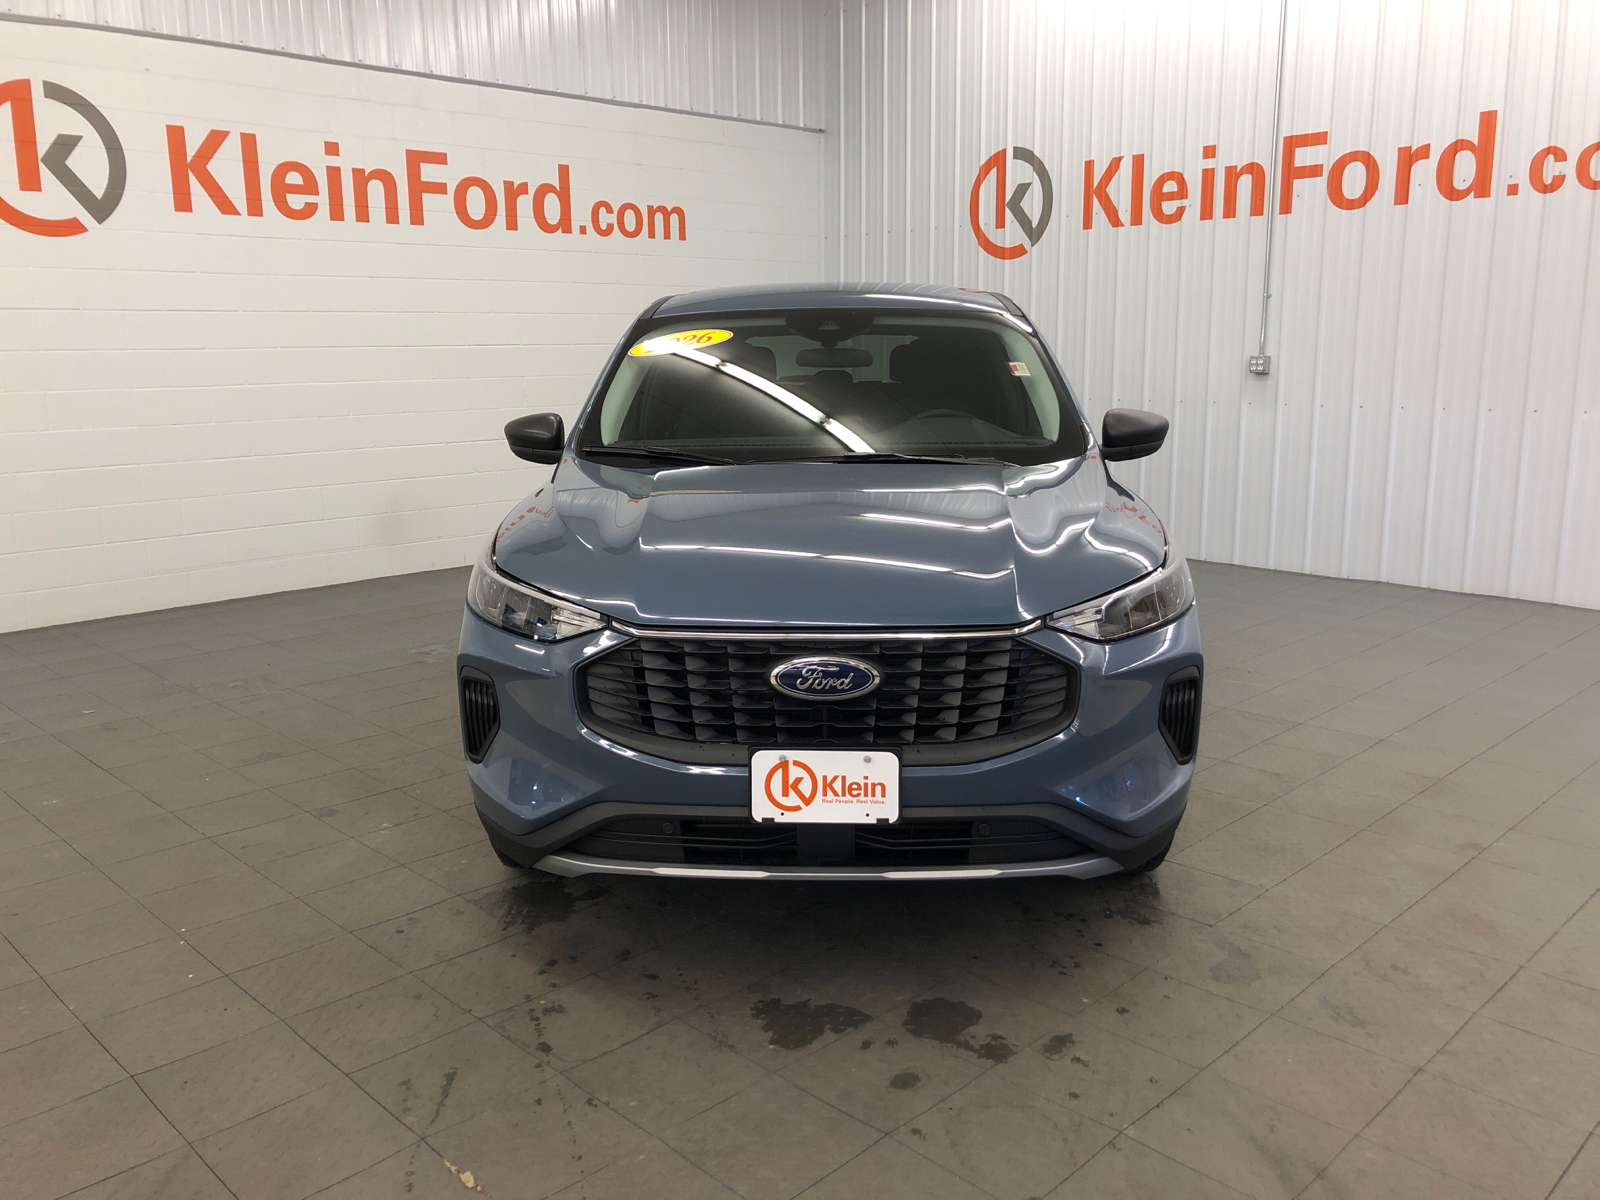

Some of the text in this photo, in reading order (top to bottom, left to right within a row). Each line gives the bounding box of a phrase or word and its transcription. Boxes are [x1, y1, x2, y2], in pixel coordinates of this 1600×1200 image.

[165, 124, 687, 242] KleinFord.com
[796, 665, 854, 690] Ford
[821, 774, 887, 798] Klein
